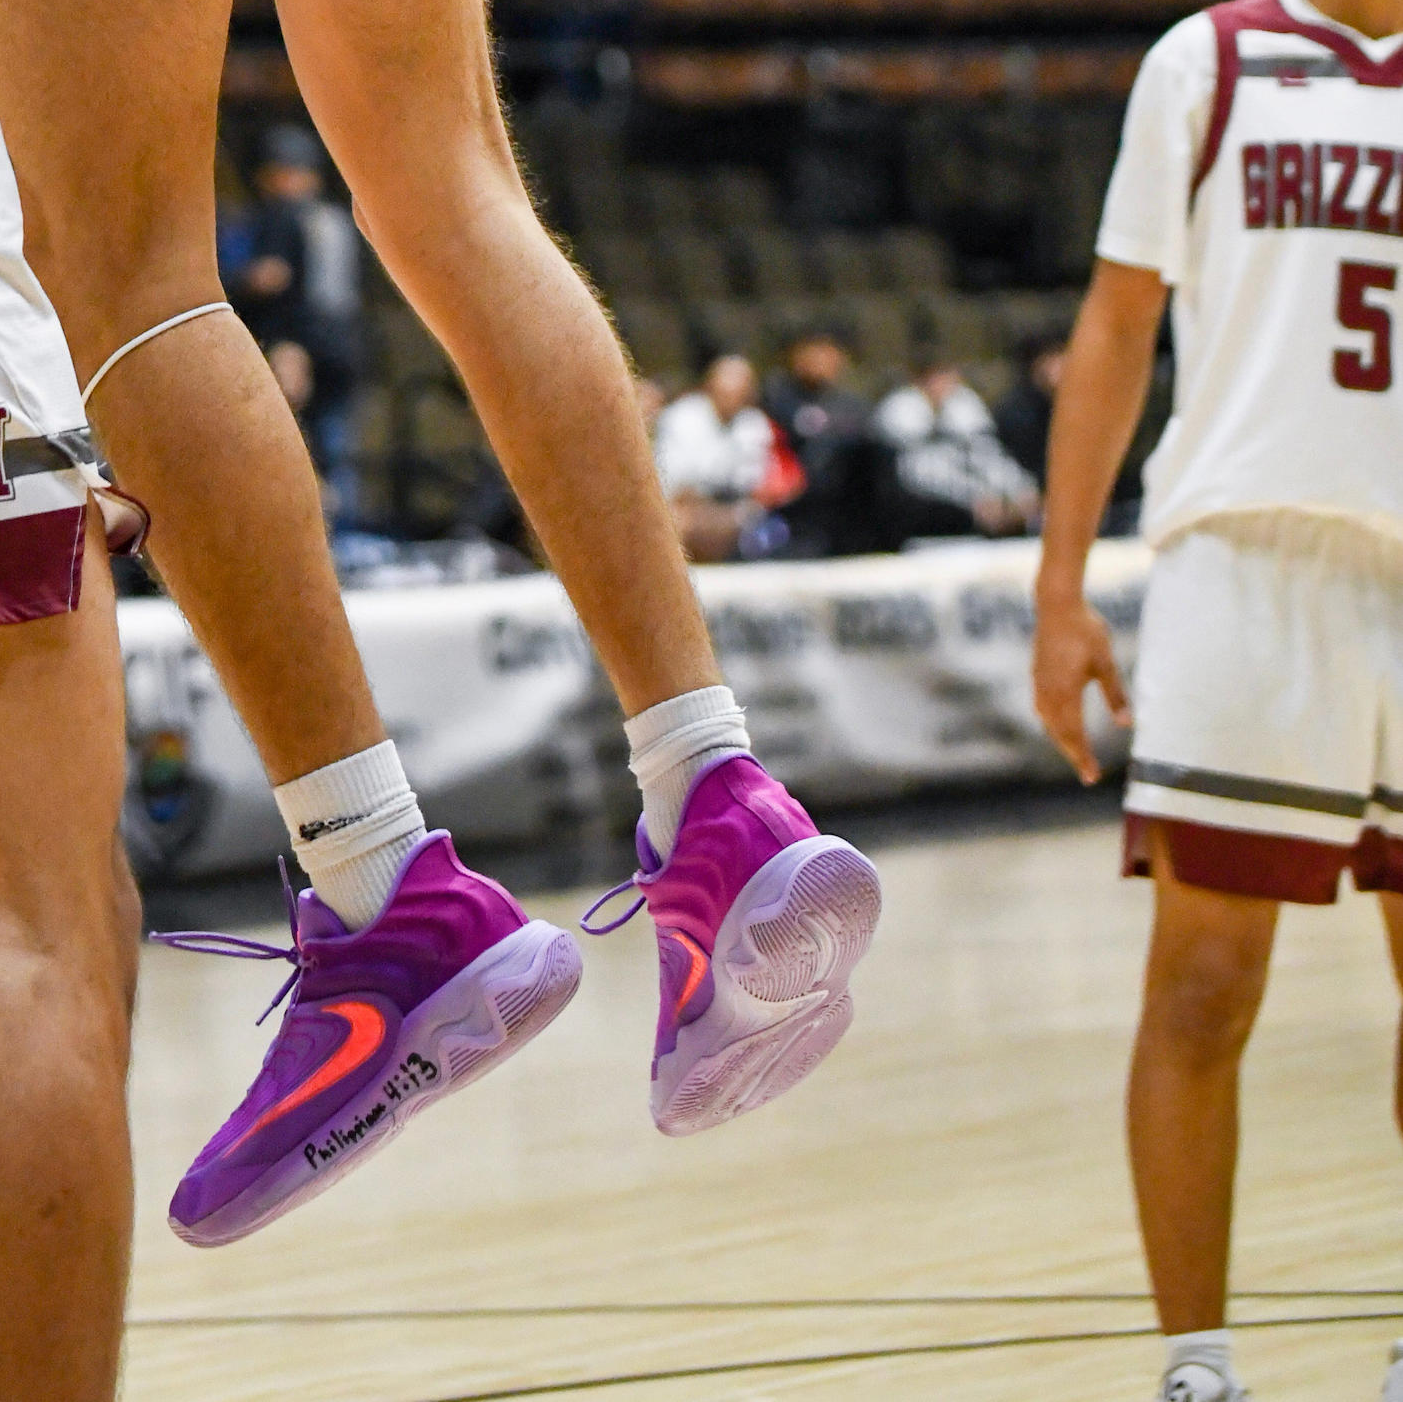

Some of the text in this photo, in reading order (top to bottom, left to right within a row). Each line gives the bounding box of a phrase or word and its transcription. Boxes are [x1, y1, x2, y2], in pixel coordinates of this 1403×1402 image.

[1241, 141, 1403, 236] GRIZZ
[1332, 259, 1397, 393] 5
[383, 1052, 438, 1101] 4:13
